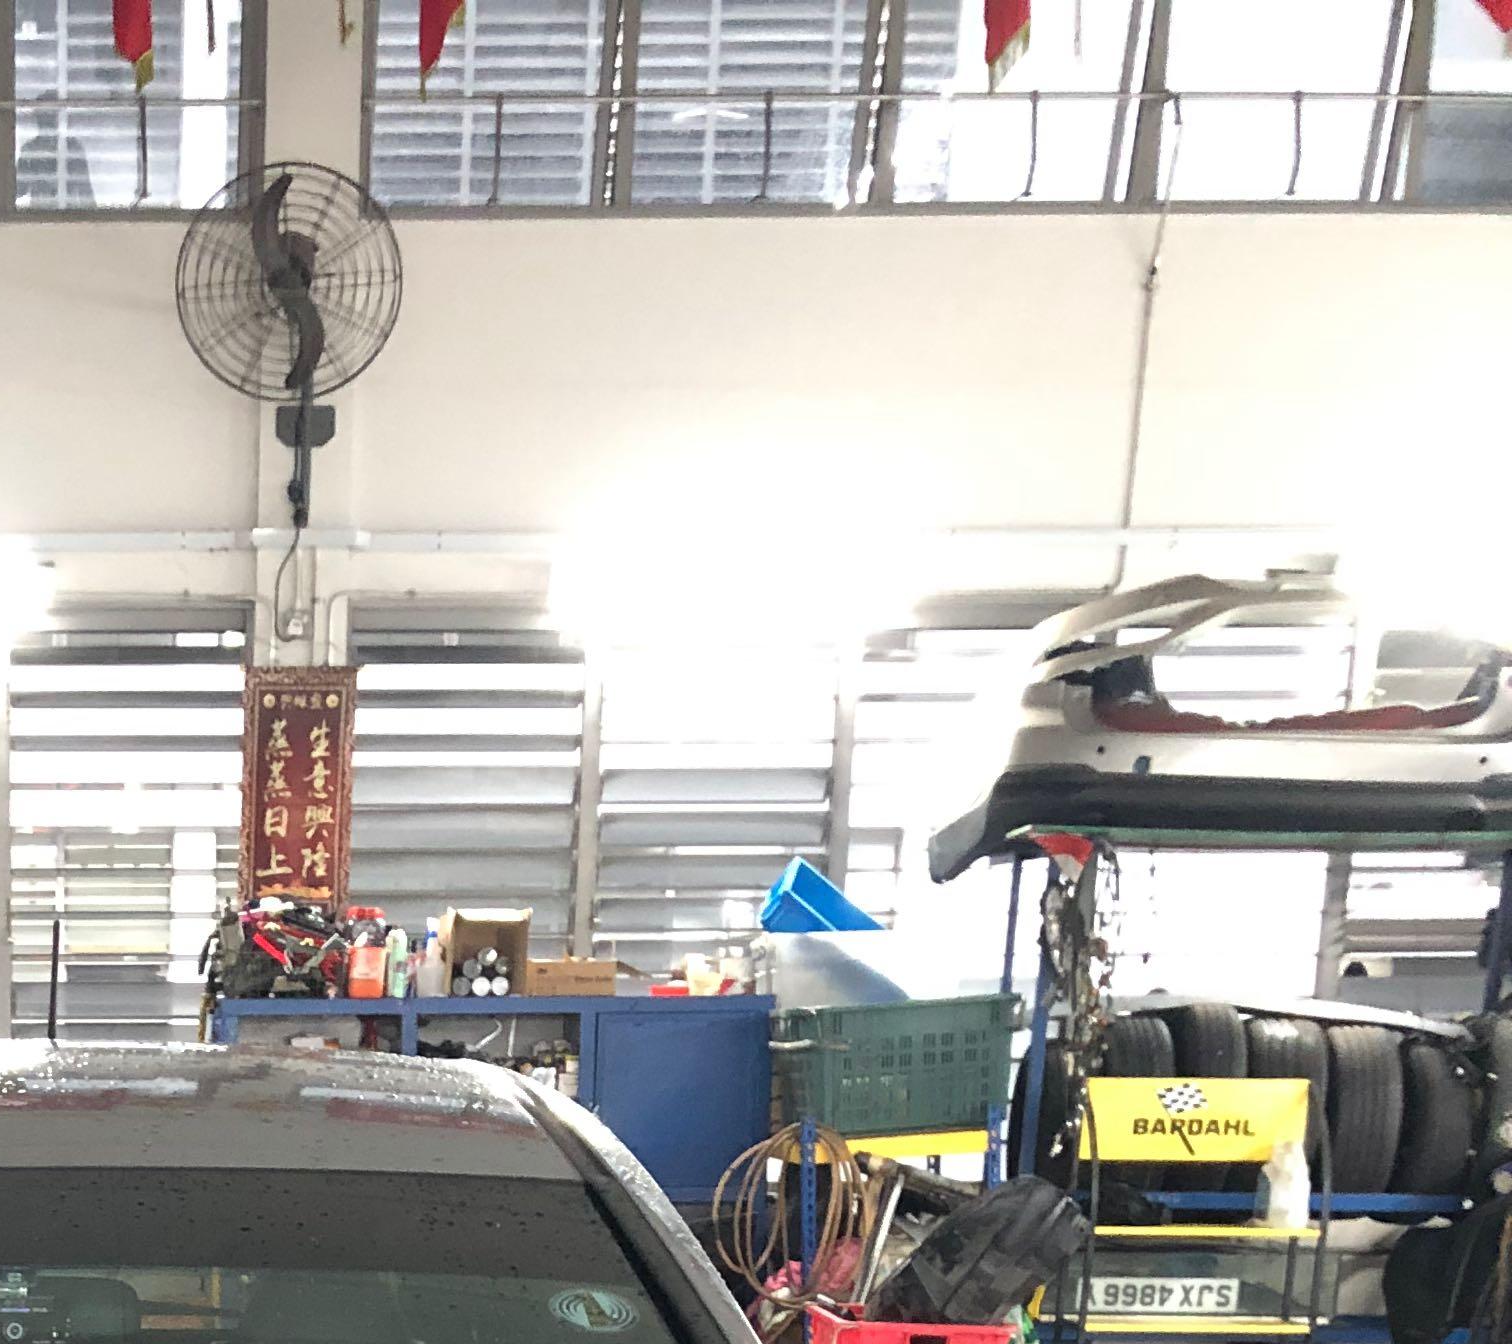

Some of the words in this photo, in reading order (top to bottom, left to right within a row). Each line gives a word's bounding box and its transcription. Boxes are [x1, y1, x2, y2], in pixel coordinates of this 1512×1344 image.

[1132, 1117, 1257, 1137] BARDAHL
[1103, 1283, 1175, 1306] 4866
[1179, 1284, 1233, 1307] SJX
